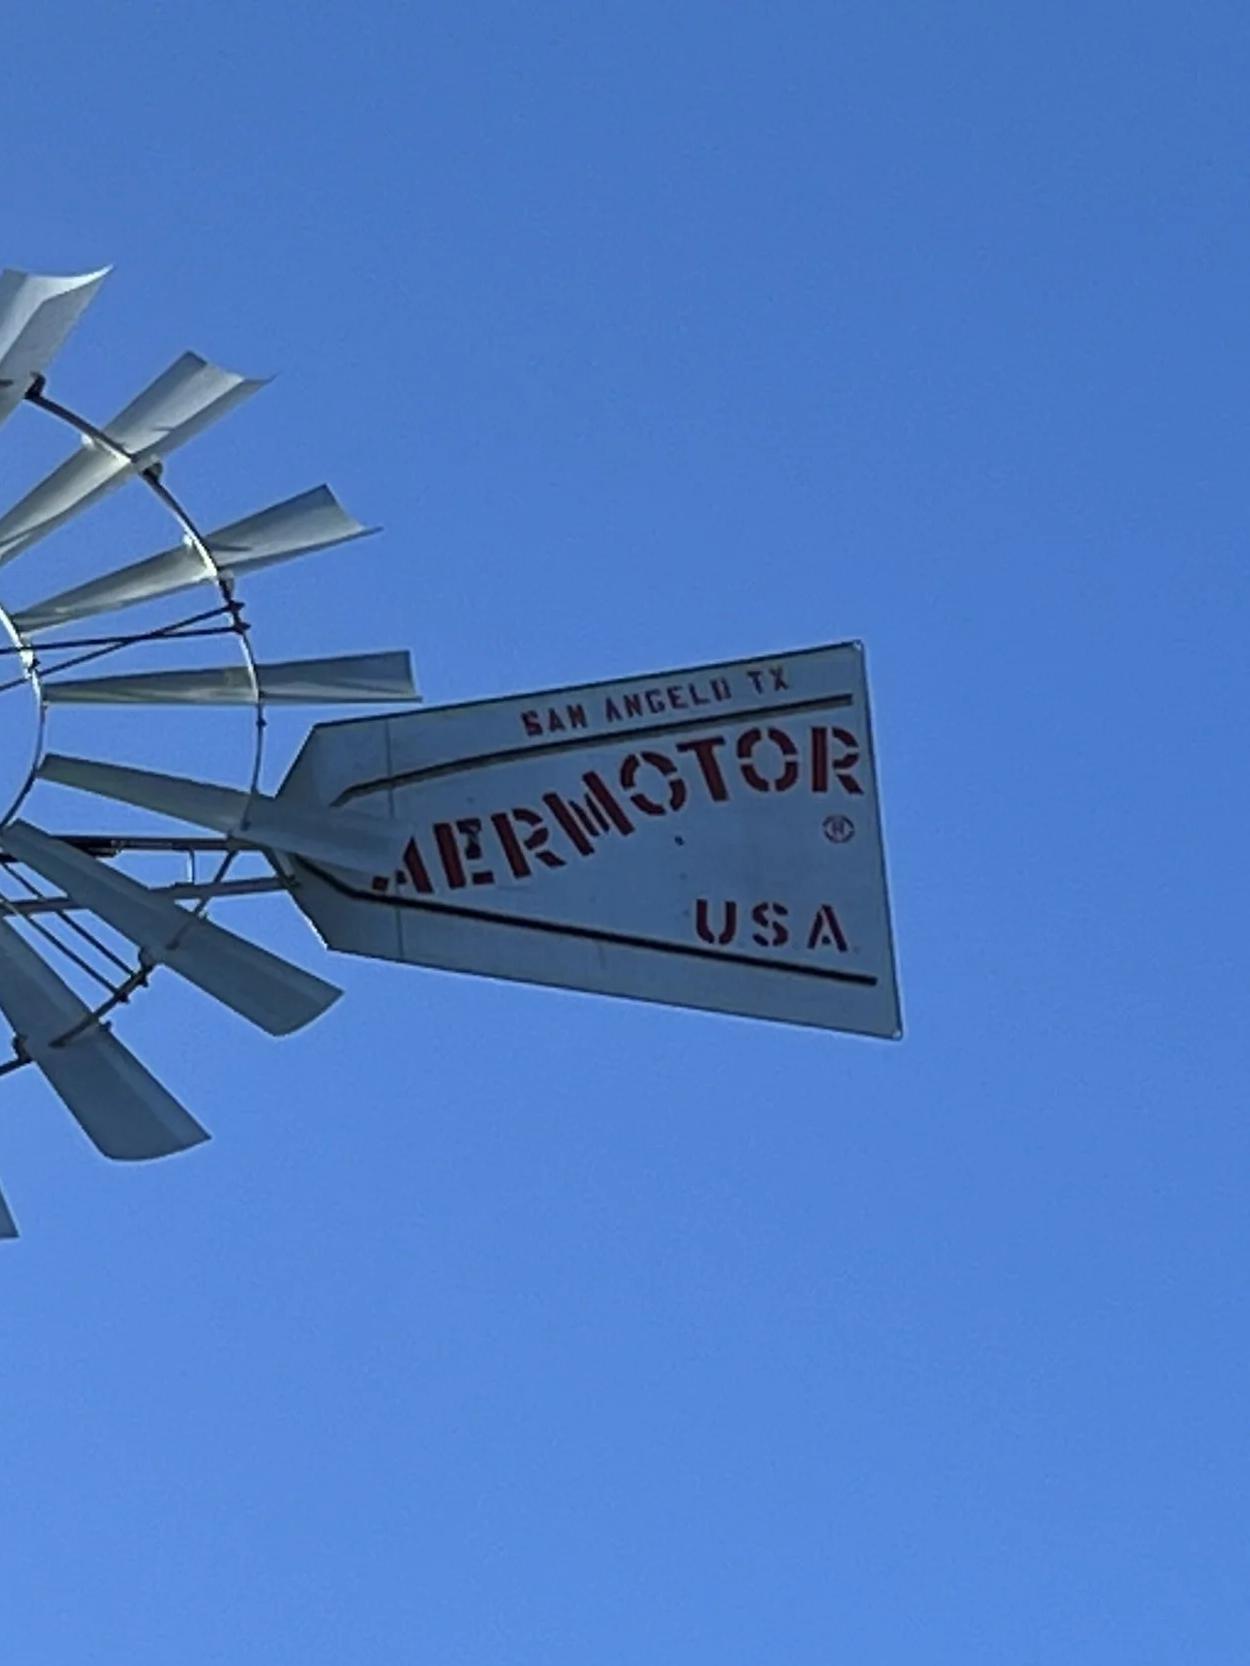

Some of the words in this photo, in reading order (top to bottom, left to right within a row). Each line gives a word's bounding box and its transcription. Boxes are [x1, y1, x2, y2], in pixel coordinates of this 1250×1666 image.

[520, 703, 589, 737] SAN
[746, 667, 790, 695] TX
[695, 899, 850, 952] USA
